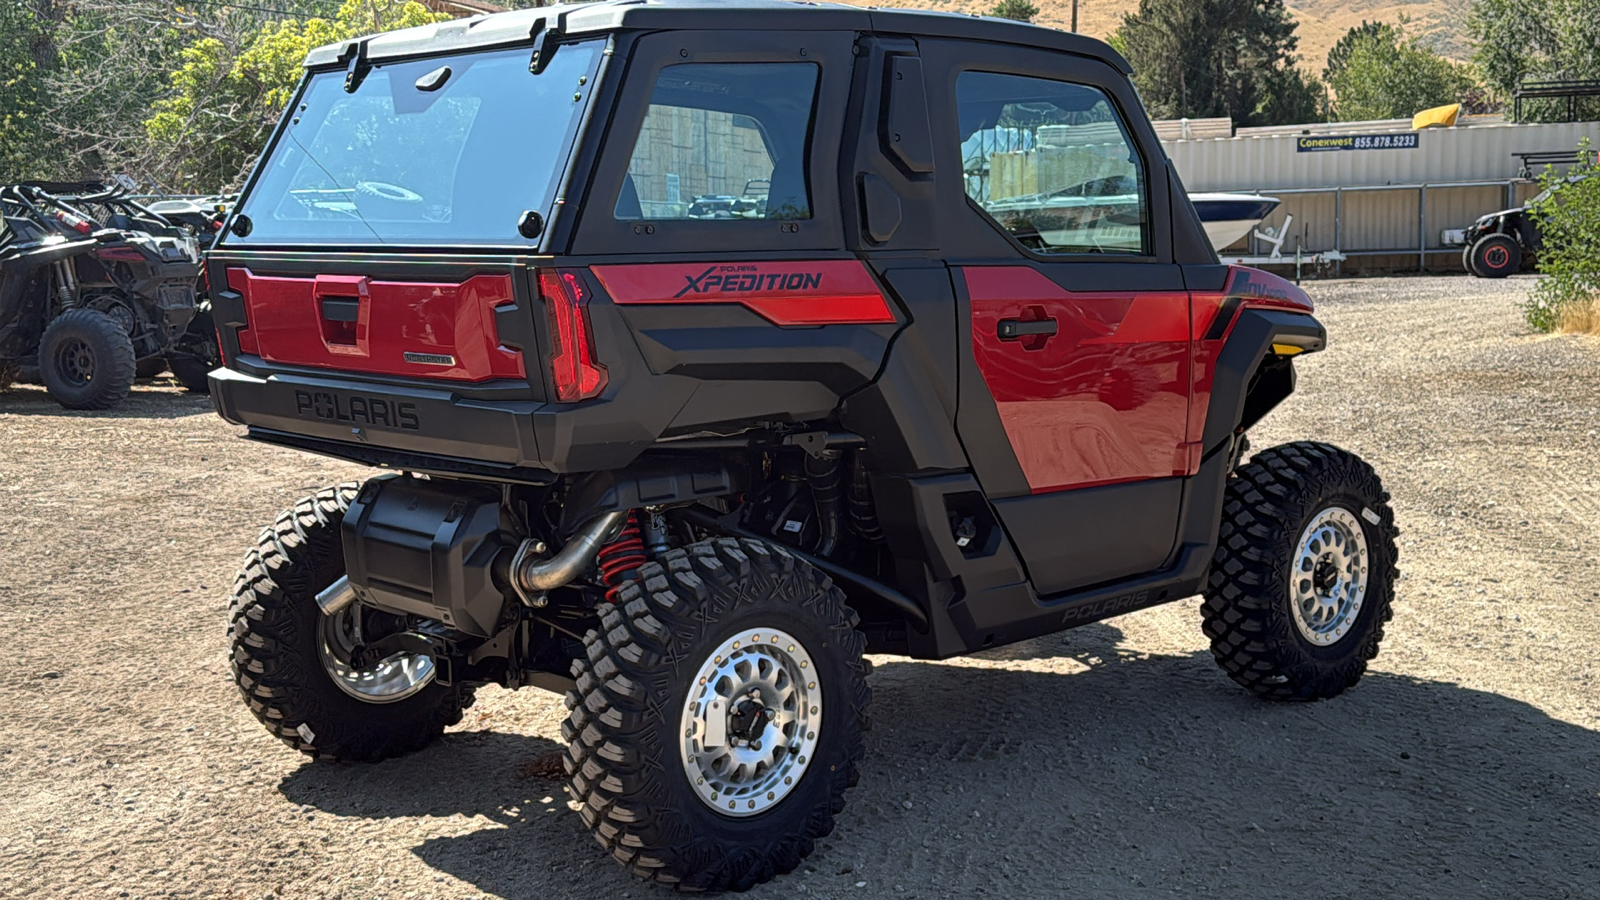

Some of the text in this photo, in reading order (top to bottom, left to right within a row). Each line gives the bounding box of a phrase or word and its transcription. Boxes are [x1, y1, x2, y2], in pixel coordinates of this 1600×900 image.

[1300, 138, 1353, 148] Conexwest
[1354, 135, 1415, 149] 855.878.5233
[673, 266, 822, 298] XPEDITION
[720, 265, 757, 273] POLARIS
[295, 389, 420, 431] POLARIS
[1062, 590, 1149, 624] POLARIS
